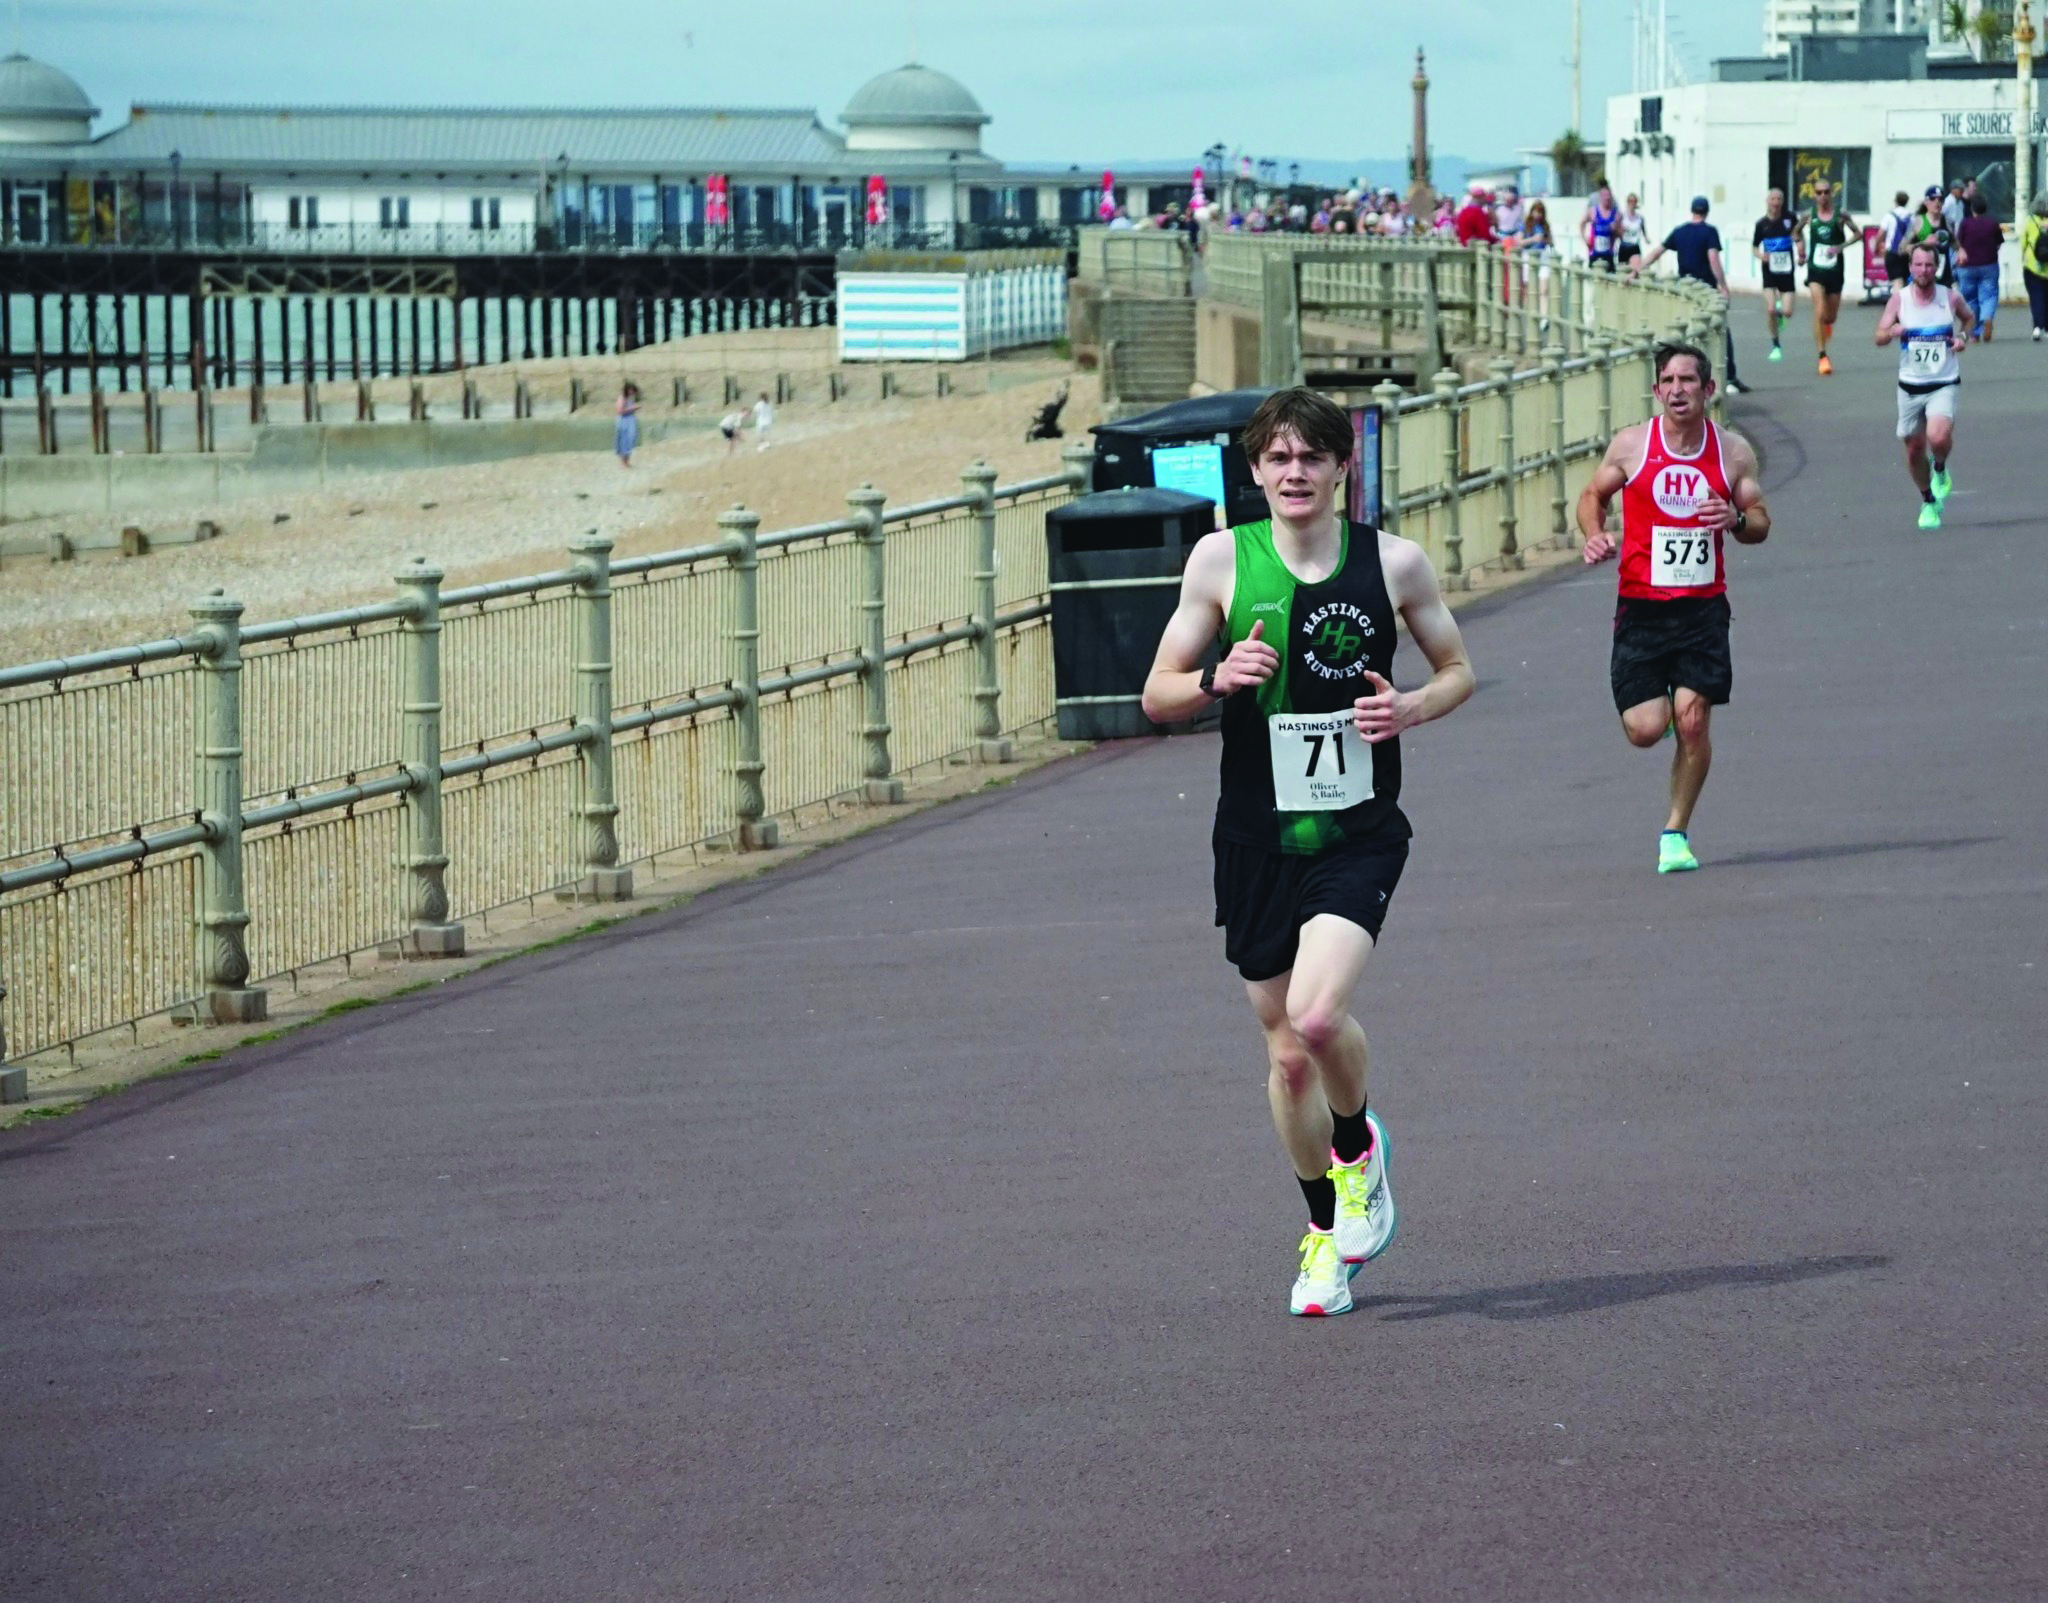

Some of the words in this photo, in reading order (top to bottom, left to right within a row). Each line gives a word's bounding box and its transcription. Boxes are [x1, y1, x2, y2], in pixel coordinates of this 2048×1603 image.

[1941, 112, 1963, 134] THE
[1967, 112, 2013, 134] SOURCE
[1914, 348, 1940, 362] 576
[1664, 471, 1701, 496] HY
[1663, 539, 1709, 565] 573
[1302, 602, 1375, 636] HASTINGS
[1311, 621, 1361, 659] HR
[1303, 650, 1370, 679] RUNNERS
[1278, 722, 1335, 731] HASTINGS
[1336, 720, 1343, 729] 5
[1303, 731, 1346, 777] 71
[1309, 782, 1339, 790] Oliver
[1320, 789, 1346, 799] Bailey
